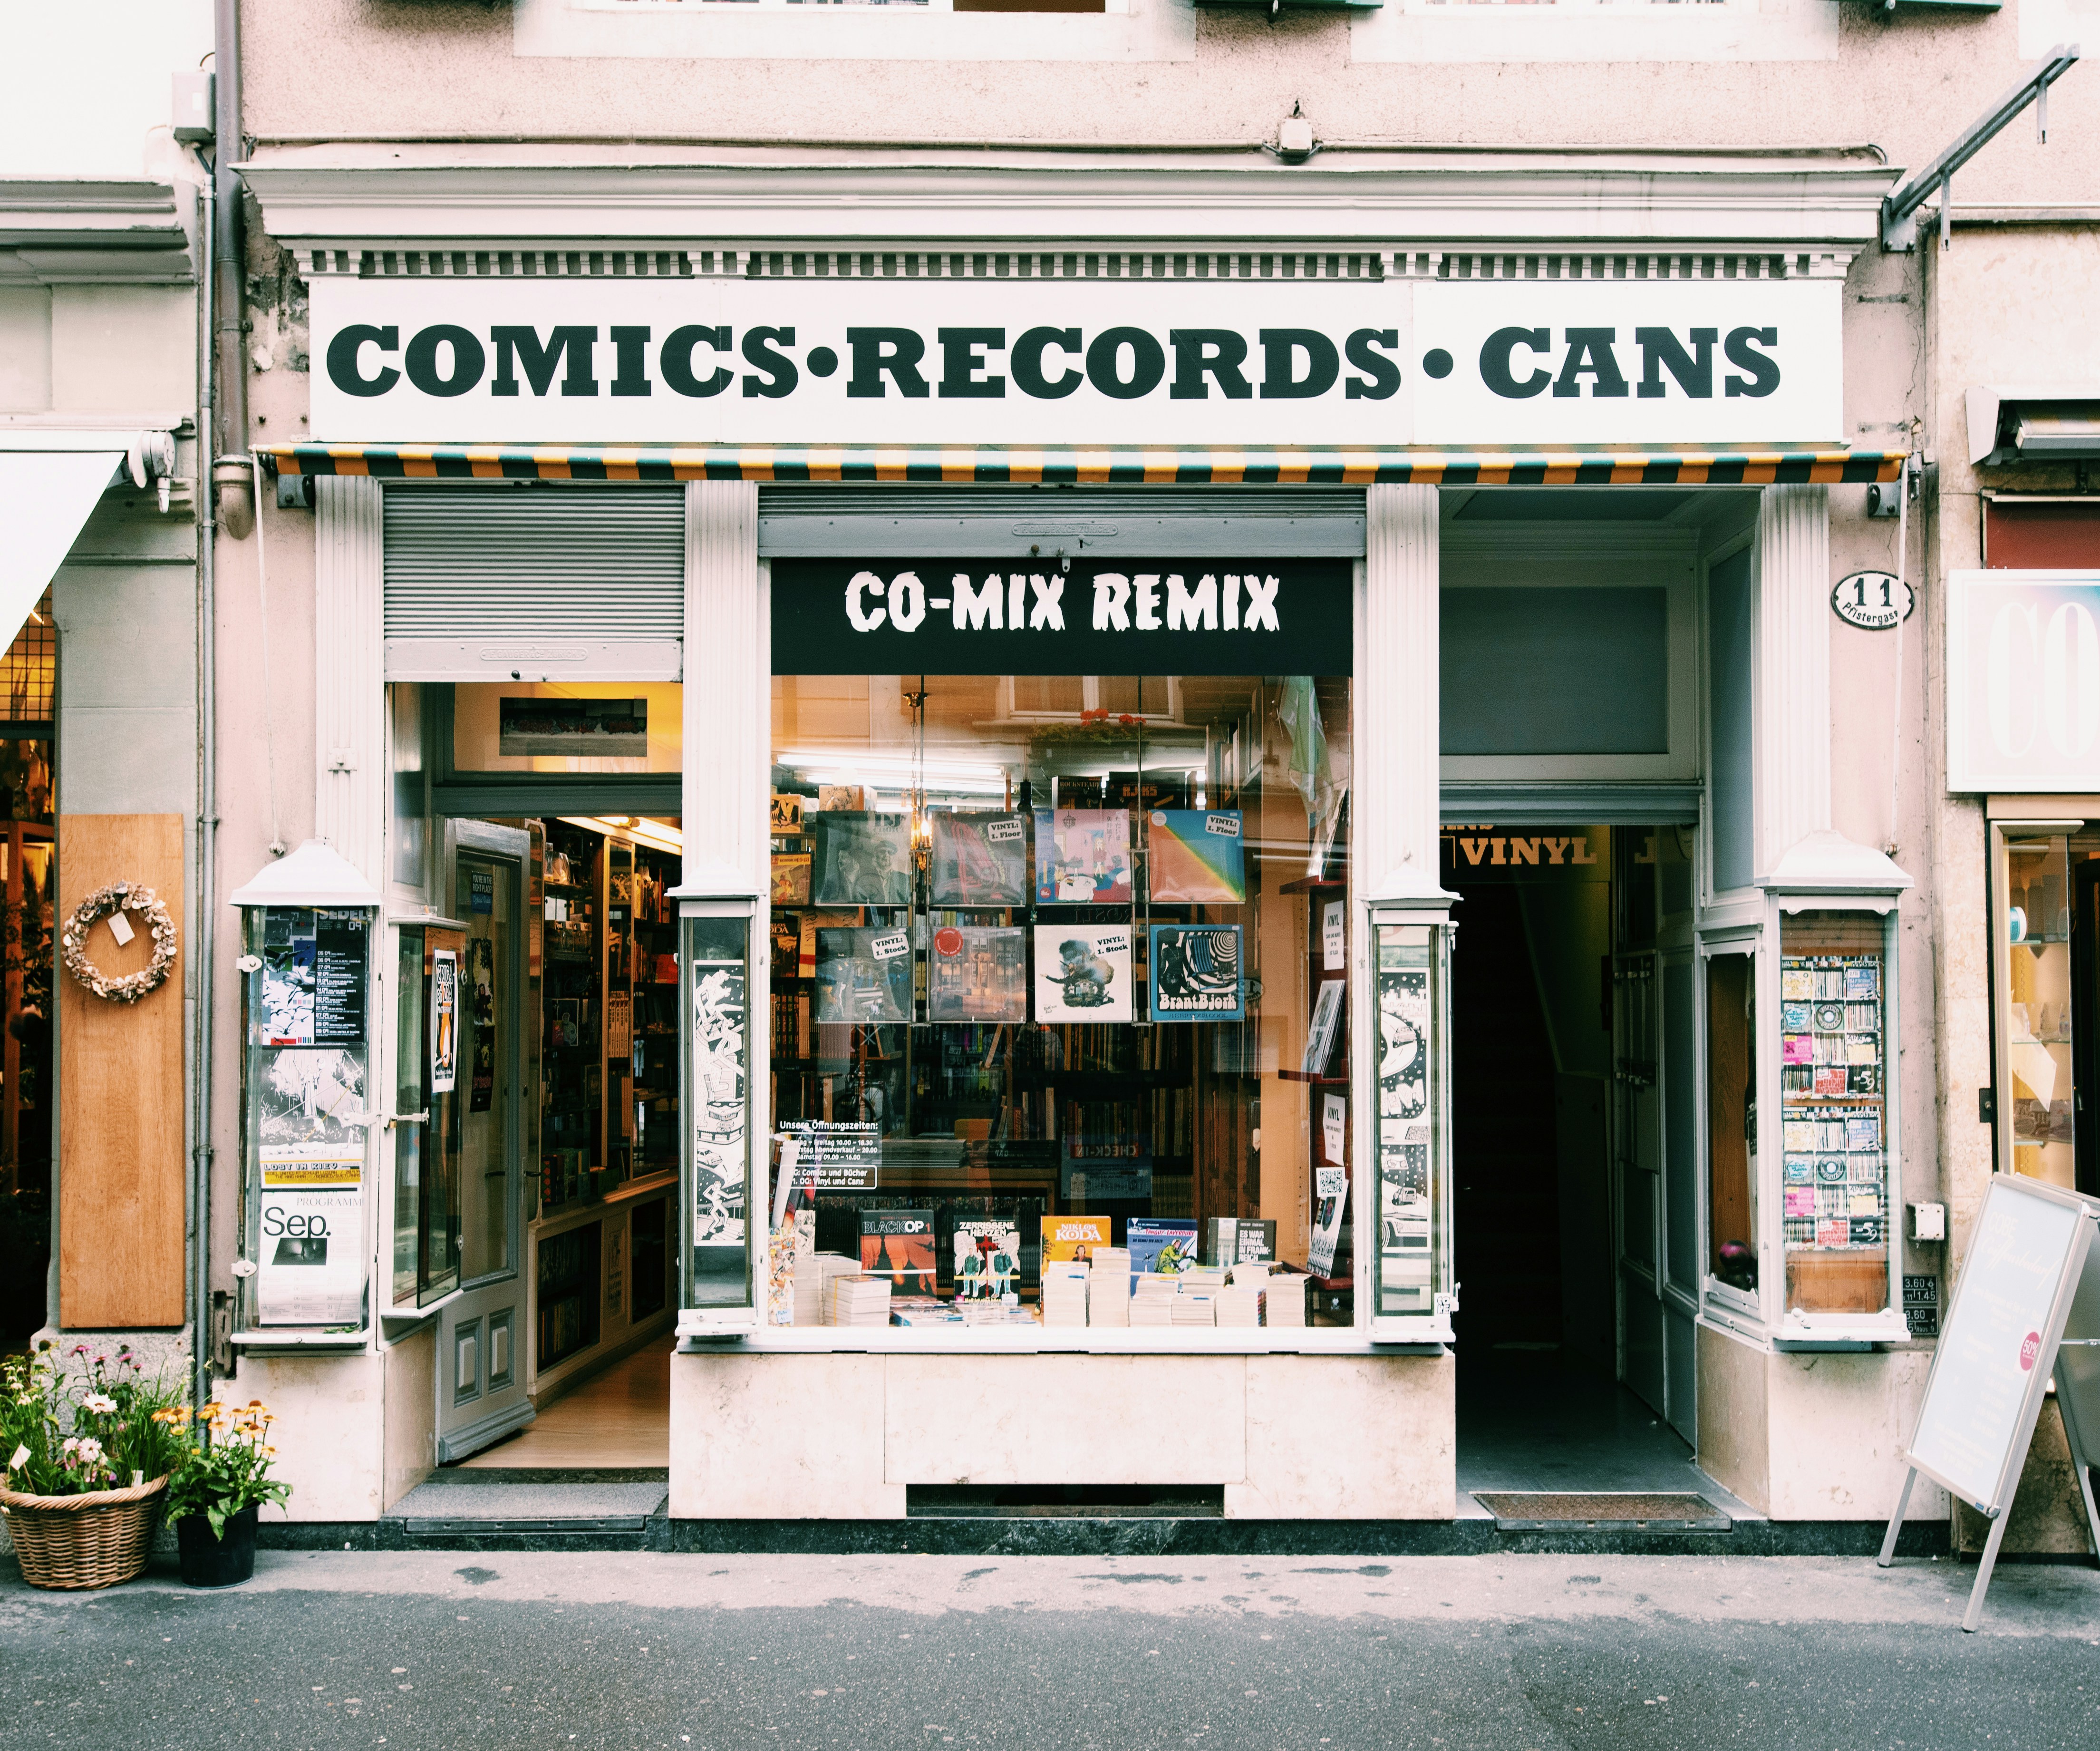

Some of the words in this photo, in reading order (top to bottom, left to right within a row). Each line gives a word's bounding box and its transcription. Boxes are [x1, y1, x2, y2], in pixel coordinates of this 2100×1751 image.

[326, 324, 799, 398] COMICS
[846, 326, 1401, 400] RECORDS
[1479, 326, 1781, 399] CANS
[1854, 577, 1893, 607] 11
[845, 571, 1065, 632] CO-MIX
[1092, 572, 1280, 632] REMIX
[991, 823, 1018, 831] VINYL:
[1210, 817, 1237, 827] VINYL:
[1216, 826, 1237, 835] Floor
[1460, 837, 1597, 866] VINYL
[319, 909, 366, 920] SEDEL
[1328, 914, 1339, 927] VINYL
[348, 921, 362, 931] 09
[875, 937, 903, 947] VINYL:
[1097, 936, 1125, 945] VINYL:
[884, 945, 907, 954] Stock
[1106, 944, 1128, 953] Stock
[1328, 1107, 1340, 1121] VINYL
[780, 1120, 810, 1129] Unsere
[812, 1119, 878, 1131] Öffnungszeiten:
[802, 1168, 827, 1177] Comics
[828, 1168, 842, 1177] und
[843, 1168, 868, 1177] Bücher
[813, 1177, 831, 1186] Vinyl
[297, 1197, 362, 1206] PROGRAMM
[263, 1206, 331, 1237] Sep.
[959, 1222, 1015, 1230] ZERRISSENE
[925, 1223, 930, 1233] 1
[1055, 1229, 1102, 1241] KODA
[1239, 1230, 1248, 1238] ES
[1248, 1230, 1264, 1239] WAR
[1239, 1238, 1265, 1246] EINMAL
[1239, 1246, 1246, 1254] IN
[1246, 1246, 1271, 1255] FRANK-
[1238, 1254, 1258, 1262] REICH
[1905, 1278, 1925, 1288] 3.60
[1917, 1291, 1935, 1300] 1.45
[1906, 1309, 1926, 1320] 3.60
[2022, 1339, 2039, 1357] 50%
